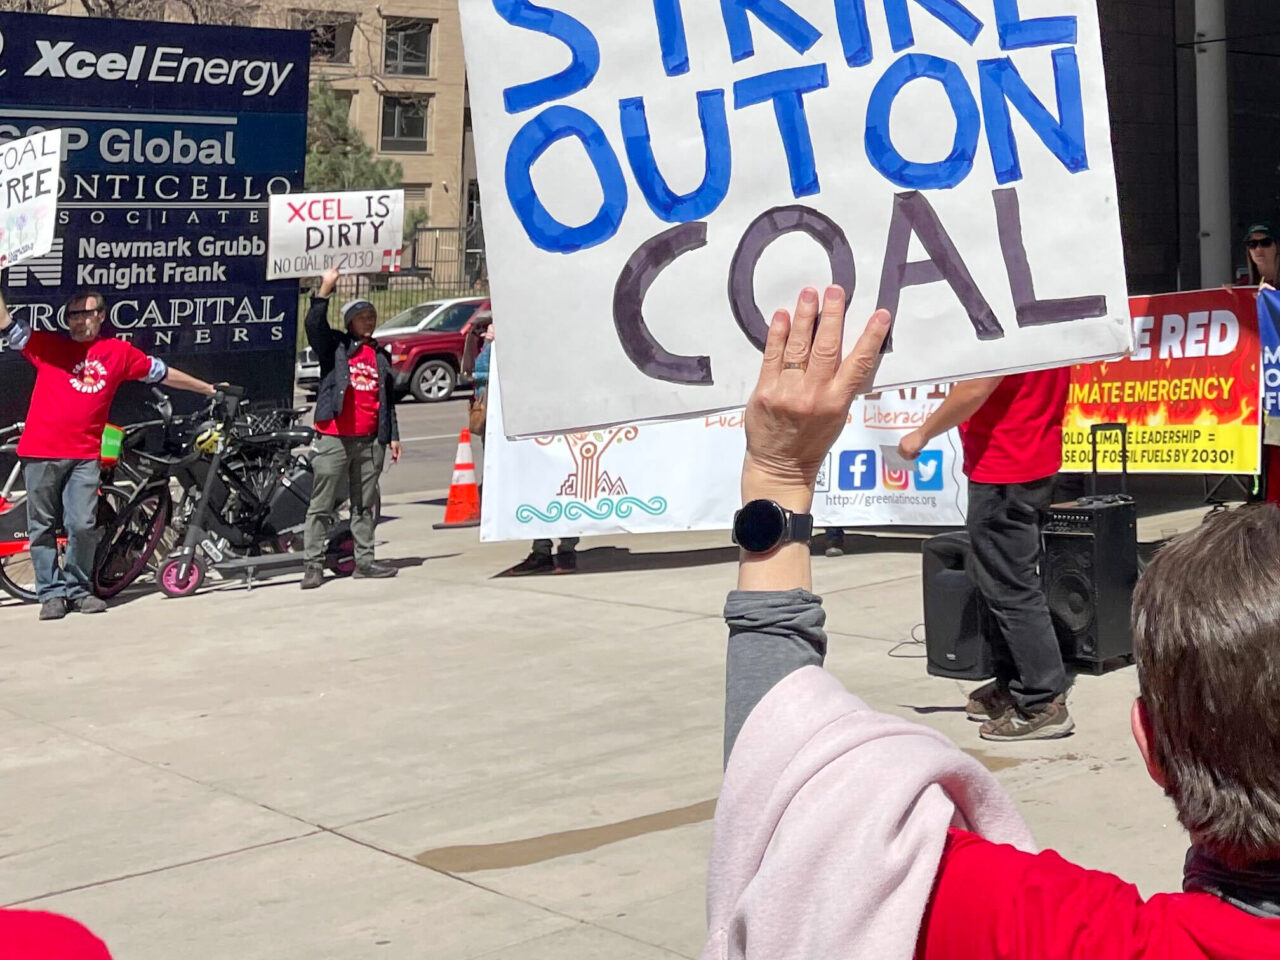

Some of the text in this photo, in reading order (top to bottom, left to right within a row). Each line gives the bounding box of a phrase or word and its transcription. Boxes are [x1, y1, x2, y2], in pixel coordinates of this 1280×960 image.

[25, 40, 293, 96] Xcel Energy
[100, 128, 236, 165] Global
[504, 47, 1089, 254] OUT ON
[0, 168, 52, 208] REE
[58, 172, 291, 201] NTICELLO
[58, 209, 259, 225] SOCIATE
[287, 195, 391, 223] XCEL IS
[78, 235, 265, 259] Newmark Grubb
[305, 220, 385, 254] DIRTY
[76, 262, 227, 289] Knight Frank
[274, 250, 374, 274] NO COAL BY 2030
[612, 186, 1108, 386] COAL
[110, 296, 285, 329] CAPITAL
[1159, 309, 1240, 360] RED
[1067, 376, 1235, 404] IMATE EMERGENCY
[1062, 431, 1084, 445] OLD
[1086, 430, 1136, 445] CIMAE
[1135, 429, 1201, 445] LEADERSHIP
[1140, 450, 1172, 463] FUELS
[1174, 449, 1190, 463] BY
[1191, 449, 1234, 465] 2030!
[825, 493, 937, 508] http://greenlatinos.org
